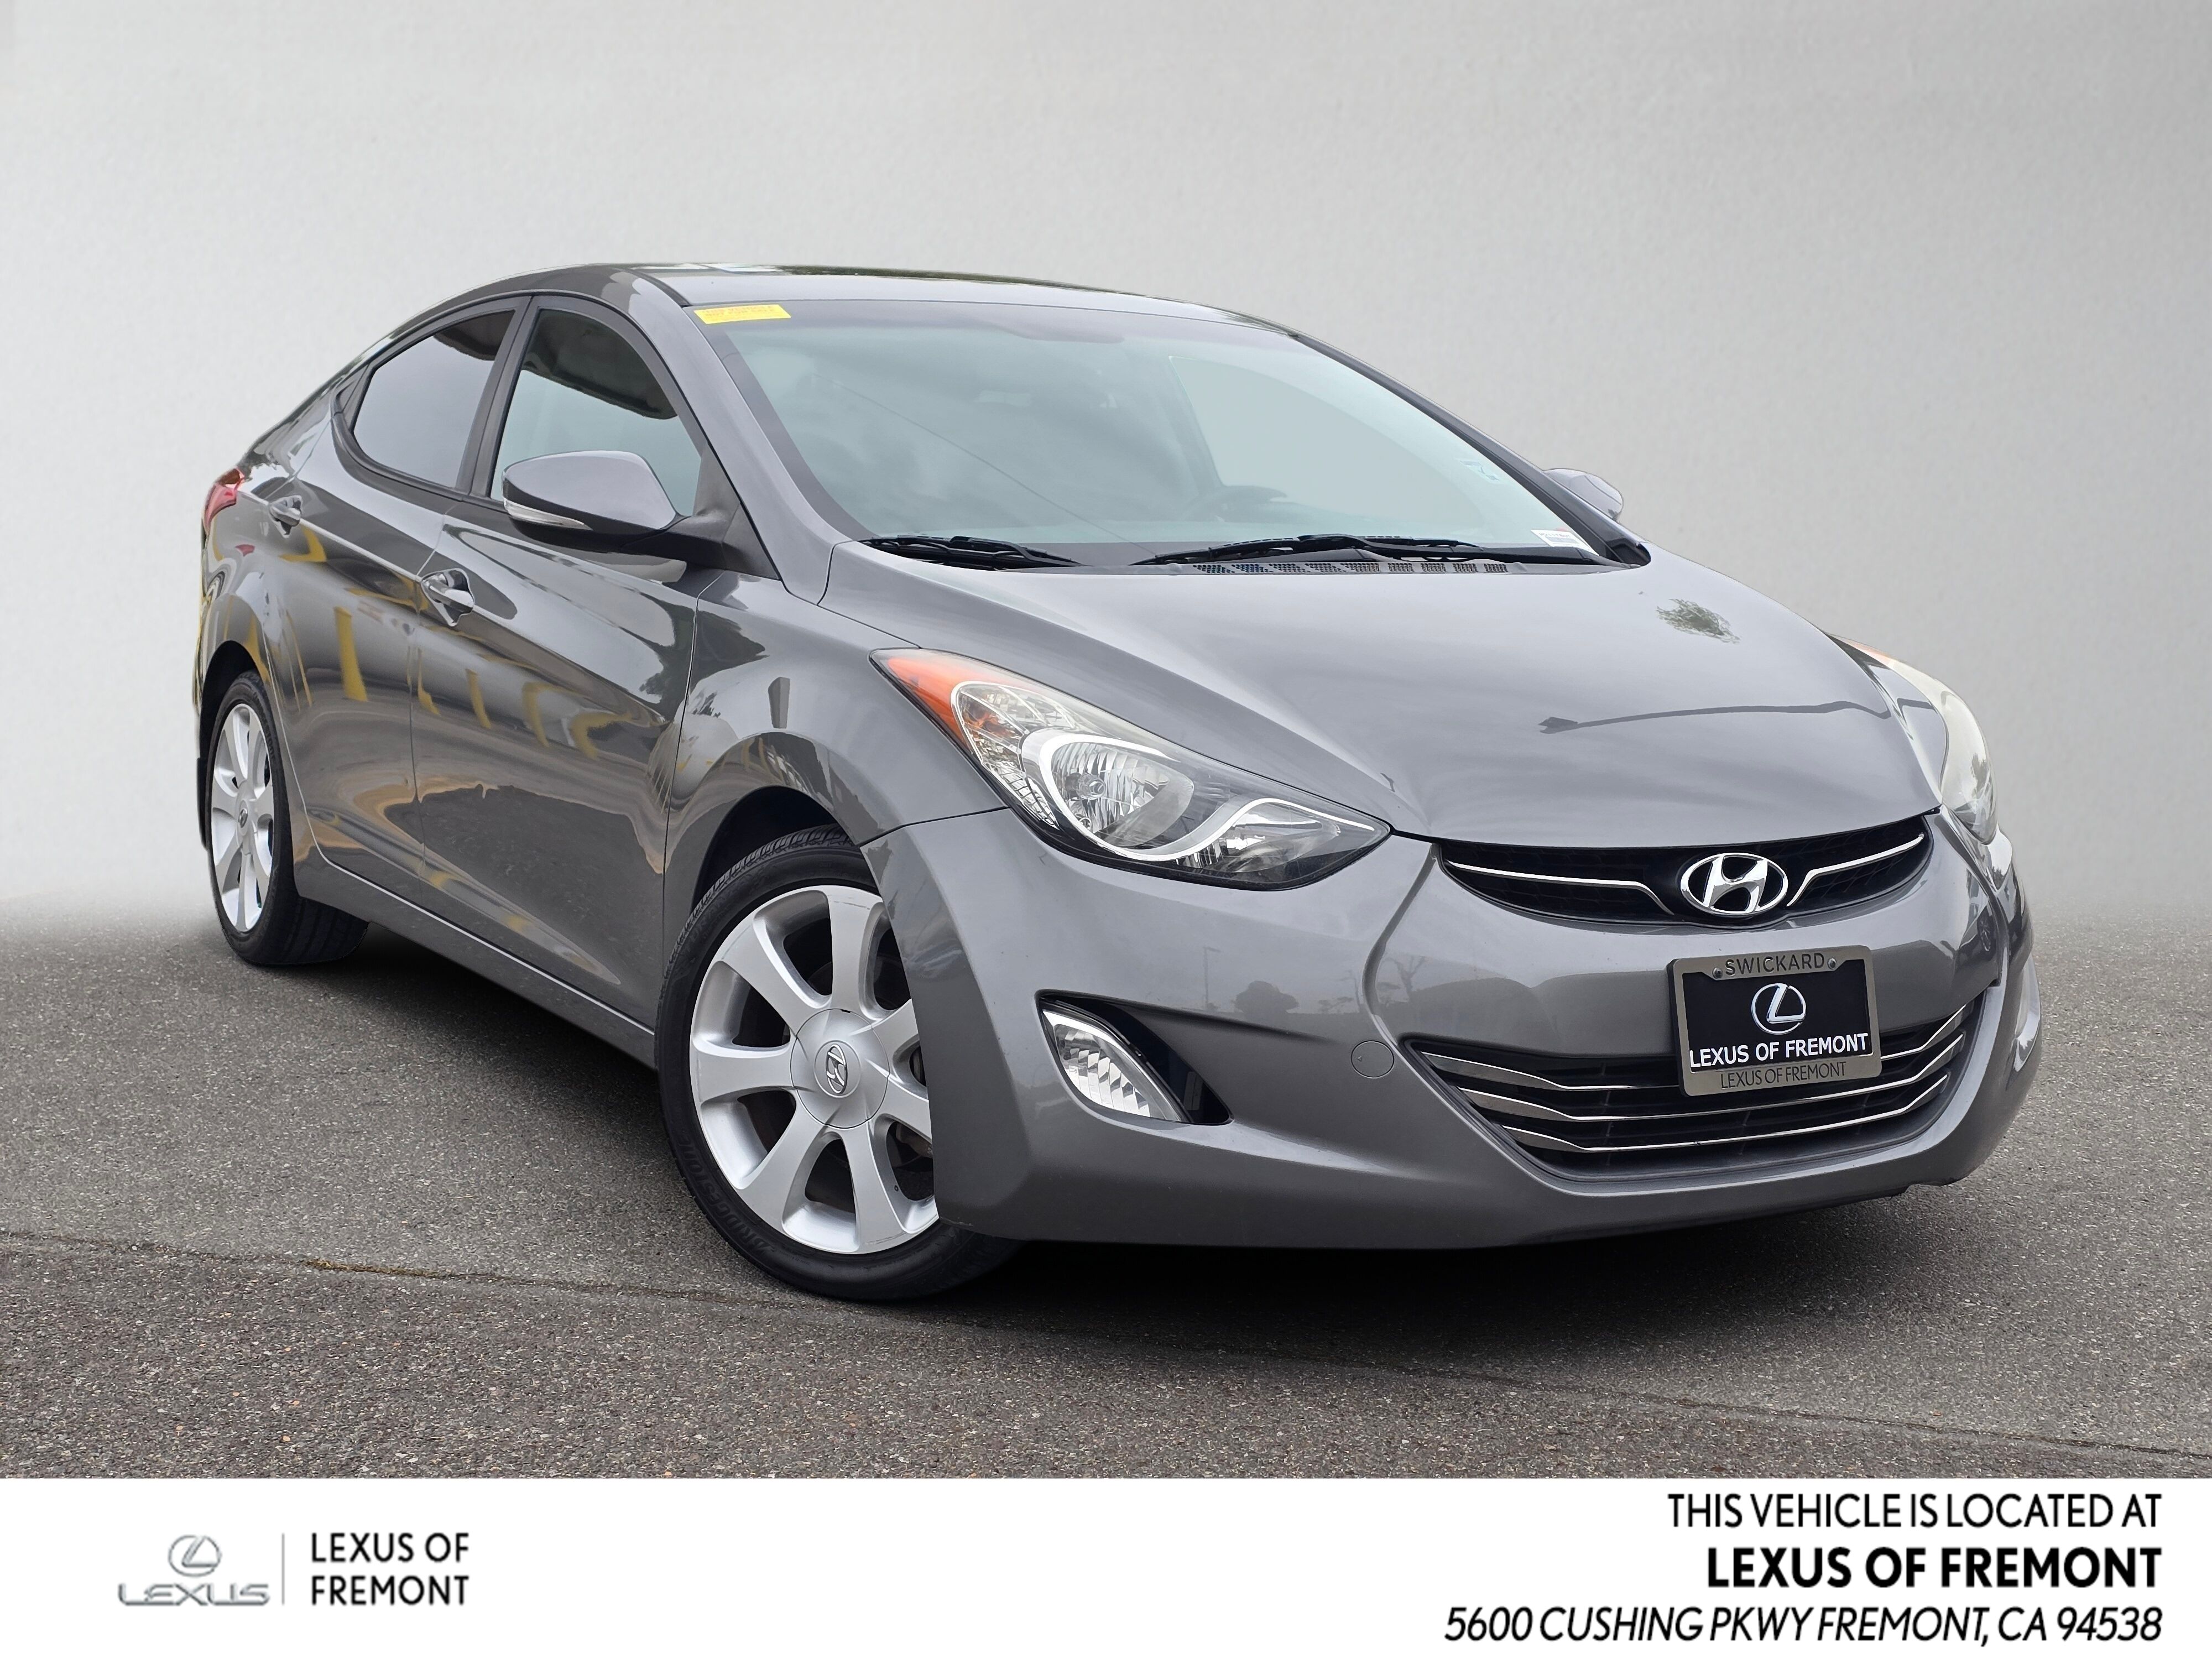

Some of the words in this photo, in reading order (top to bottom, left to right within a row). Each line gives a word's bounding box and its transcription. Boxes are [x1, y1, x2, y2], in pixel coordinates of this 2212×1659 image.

[1725, 953, 1825, 977] SWICKARD
[1689, 1045, 1749, 1068] LEXUS
[1755, 1041, 1780, 1061] OF
[1785, 1033, 1869, 1058] FREMONT
[1720, 1070, 1762, 1089] LEXUS
[1765, 1067, 1783, 1084] OF
[1785, 1061, 1847, 1081] FREMONT
